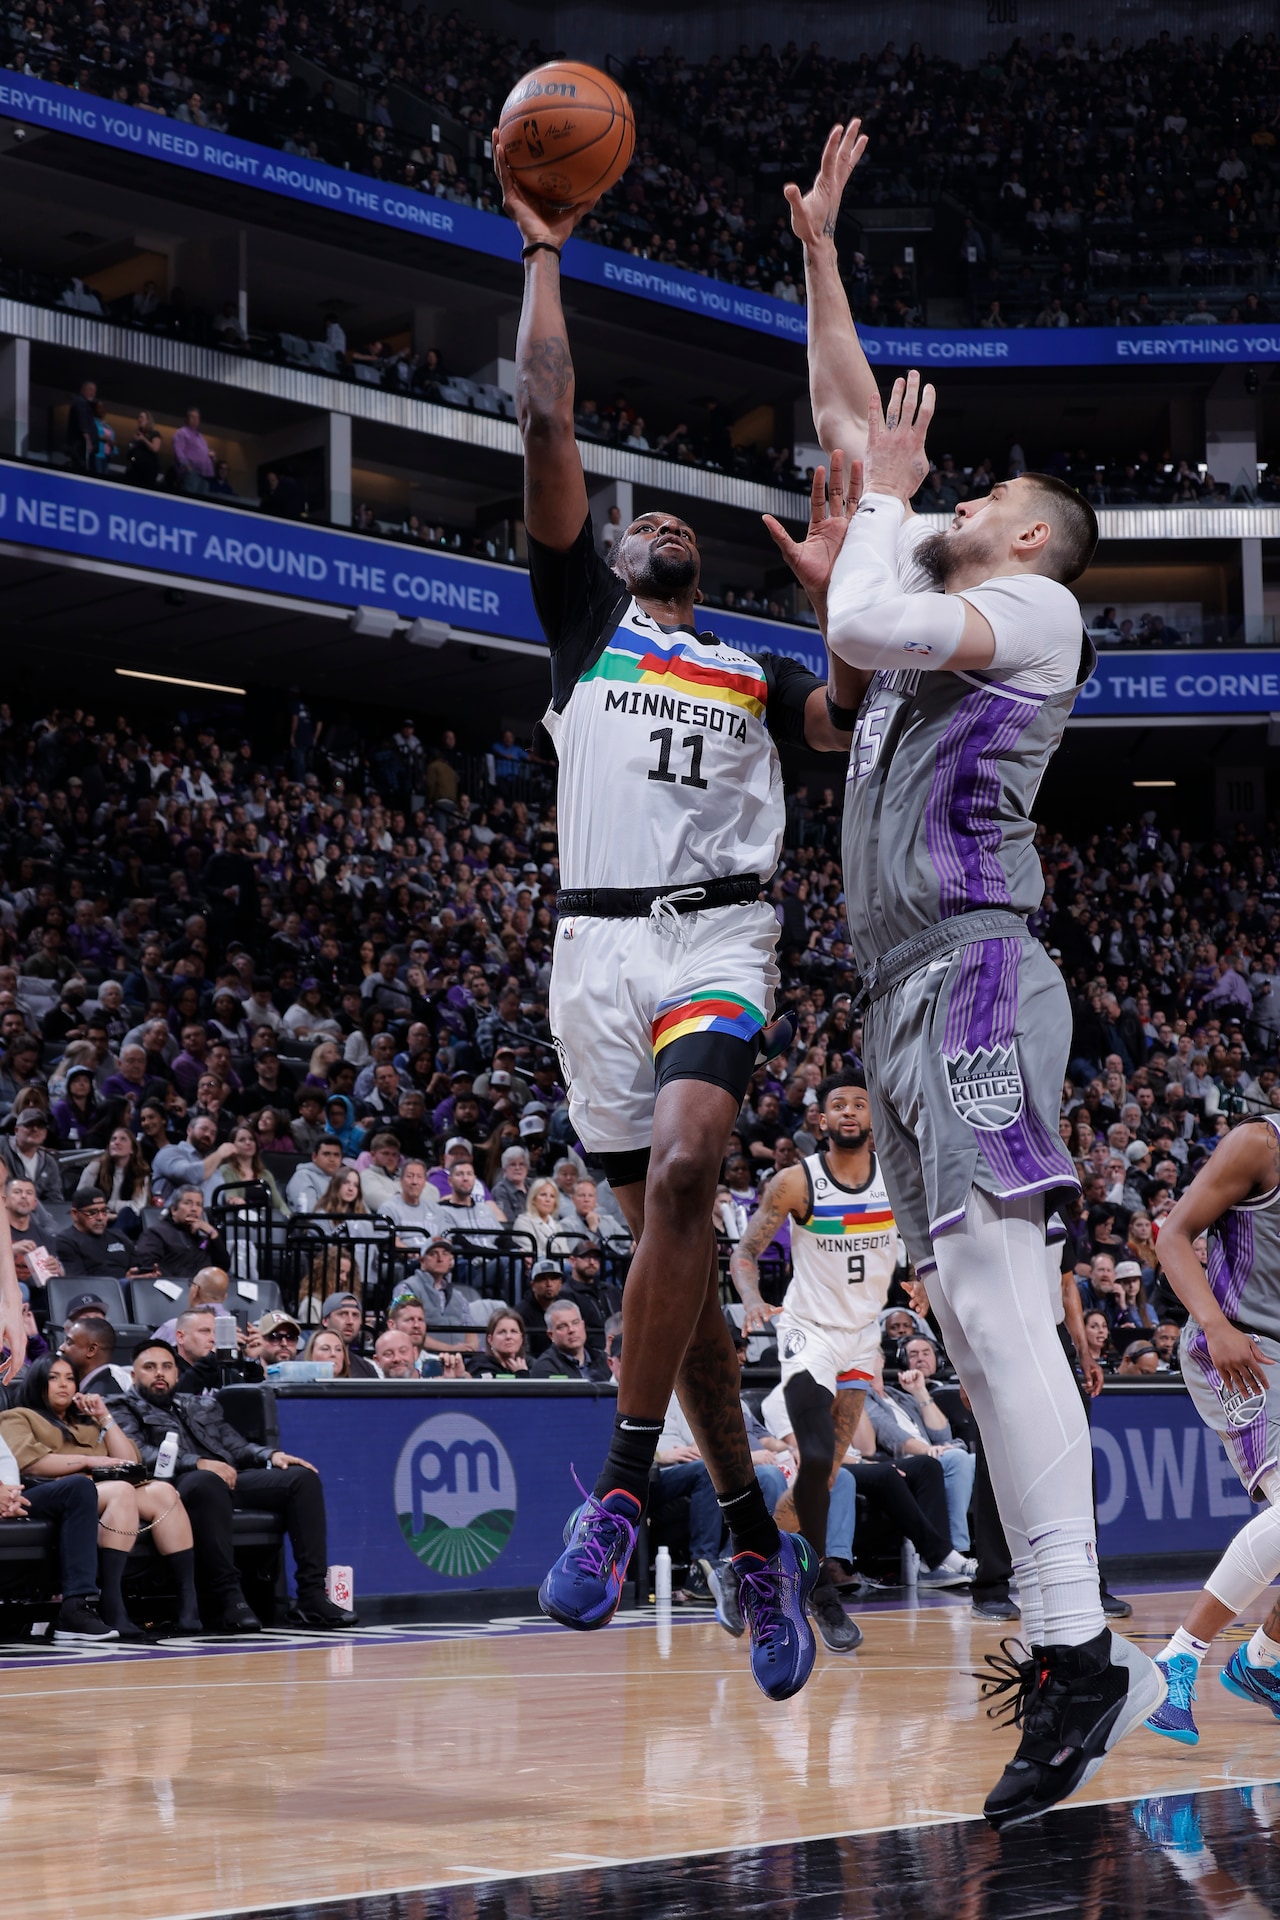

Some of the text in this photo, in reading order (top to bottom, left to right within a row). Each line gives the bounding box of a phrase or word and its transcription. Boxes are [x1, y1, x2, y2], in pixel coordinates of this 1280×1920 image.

[102, 115, 142, 142] YOU
[148, 129, 199, 158] NEED
[204, 145, 259, 175] RIGHT
[263, 164, 342, 199] AROUND
[345, 186, 379, 211] THE
[383, 198, 454, 232] CORNER
[604, 262, 808, 335] EVERYTHING YOU NEED RIGH
[885, 340, 923, 357] THE
[927, 342, 1009, 358] CORNER
[1116, 338, 1239, 356] EVERYTHING
[16, 496, 100, 536] NEED
[108, 514, 198, 556] RIGHT
[203, 535, 327, 581] AROUND
[333, 560, 387, 593] THE
[393, 572, 500, 616] CORNER
[1108, 676, 1167, 699] THE
[1175, 674, 1280, 697] CORNE
[605, 689, 747, 744] MINNESOTA
[648, 727, 708, 790] 11
[951, 1069, 1018, 1084] SACRAMENTO
[951, 1078, 1022, 1103] KINGS
[816, 1179, 826, 1190] 6
[816, 1235, 890, 1253] MINNESOTA
[848, 1254, 865, 1285] 9
[410, 1439, 501, 1537] pm
